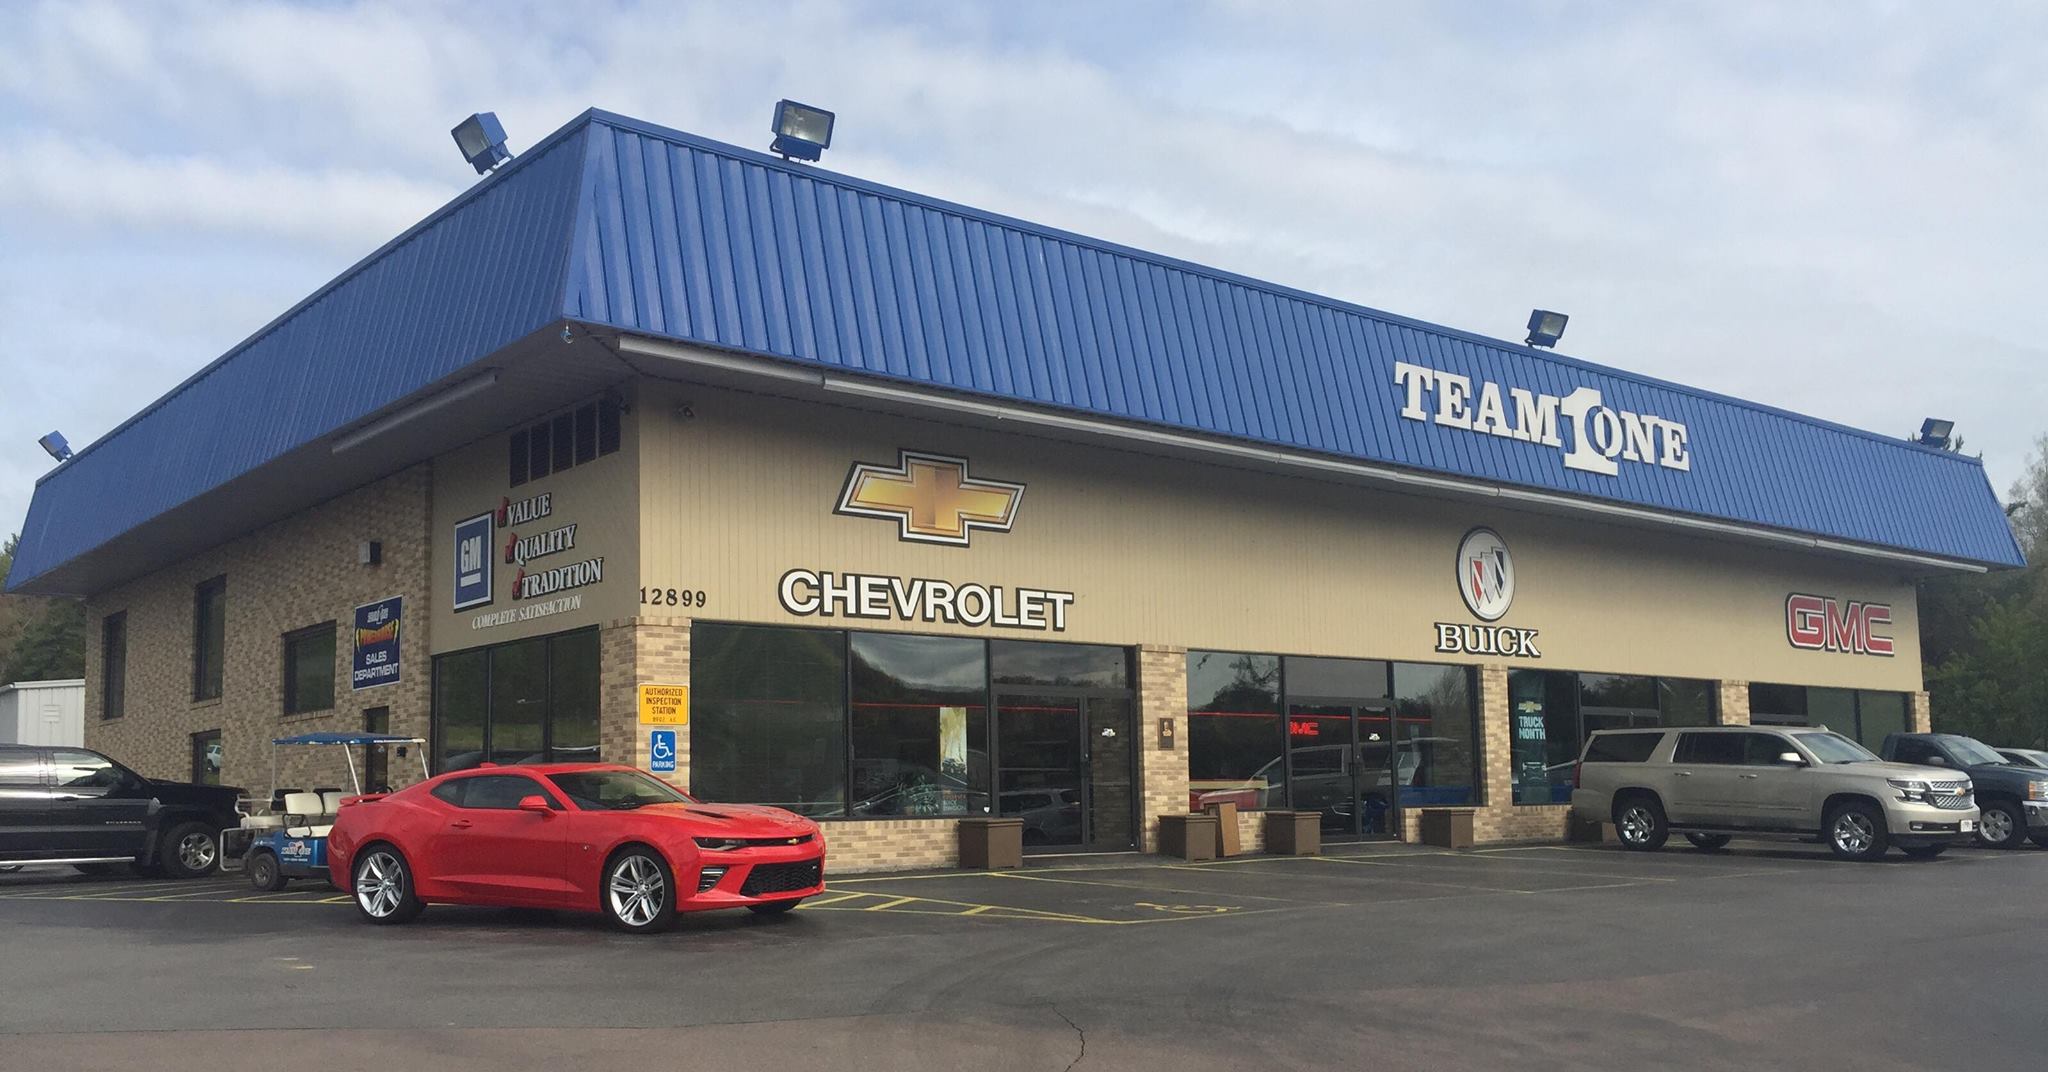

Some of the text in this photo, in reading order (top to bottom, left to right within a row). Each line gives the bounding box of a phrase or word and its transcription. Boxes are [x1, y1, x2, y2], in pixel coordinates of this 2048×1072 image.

[1394, 361, 1562, 448] TEAM
[1593, 405, 1690, 472] ONE
[506, 493, 551, 526] VALUE
[460, 536, 482, 574] GM
[514, 524, 577, 566] QUALITY
[521, 557, 604, 600] TRADITION
[640, 581, 707, 609] 12899
[778, 568, 1075, 633] CHEVROLET
[472, 594, 582, 630] COMPLETE SATISFACTION
[1785, 592, 1895, 657] GMC
[1434, 622, 1541, 658] BUICK
[354, 662, 399, 681] DEPARTMENT
[365, 651, 388, 665] SALES
[645, 687, 683, 697] AUTHORIZED
[646, 697, 682, 706] INSPECTION
[651, 706, 677, 715] STATION
[1518, 716, 1545, 728] TRUCK
[1518, 728, 1546, 740] MONTH
[652, 760, 674, 769] PARKING
